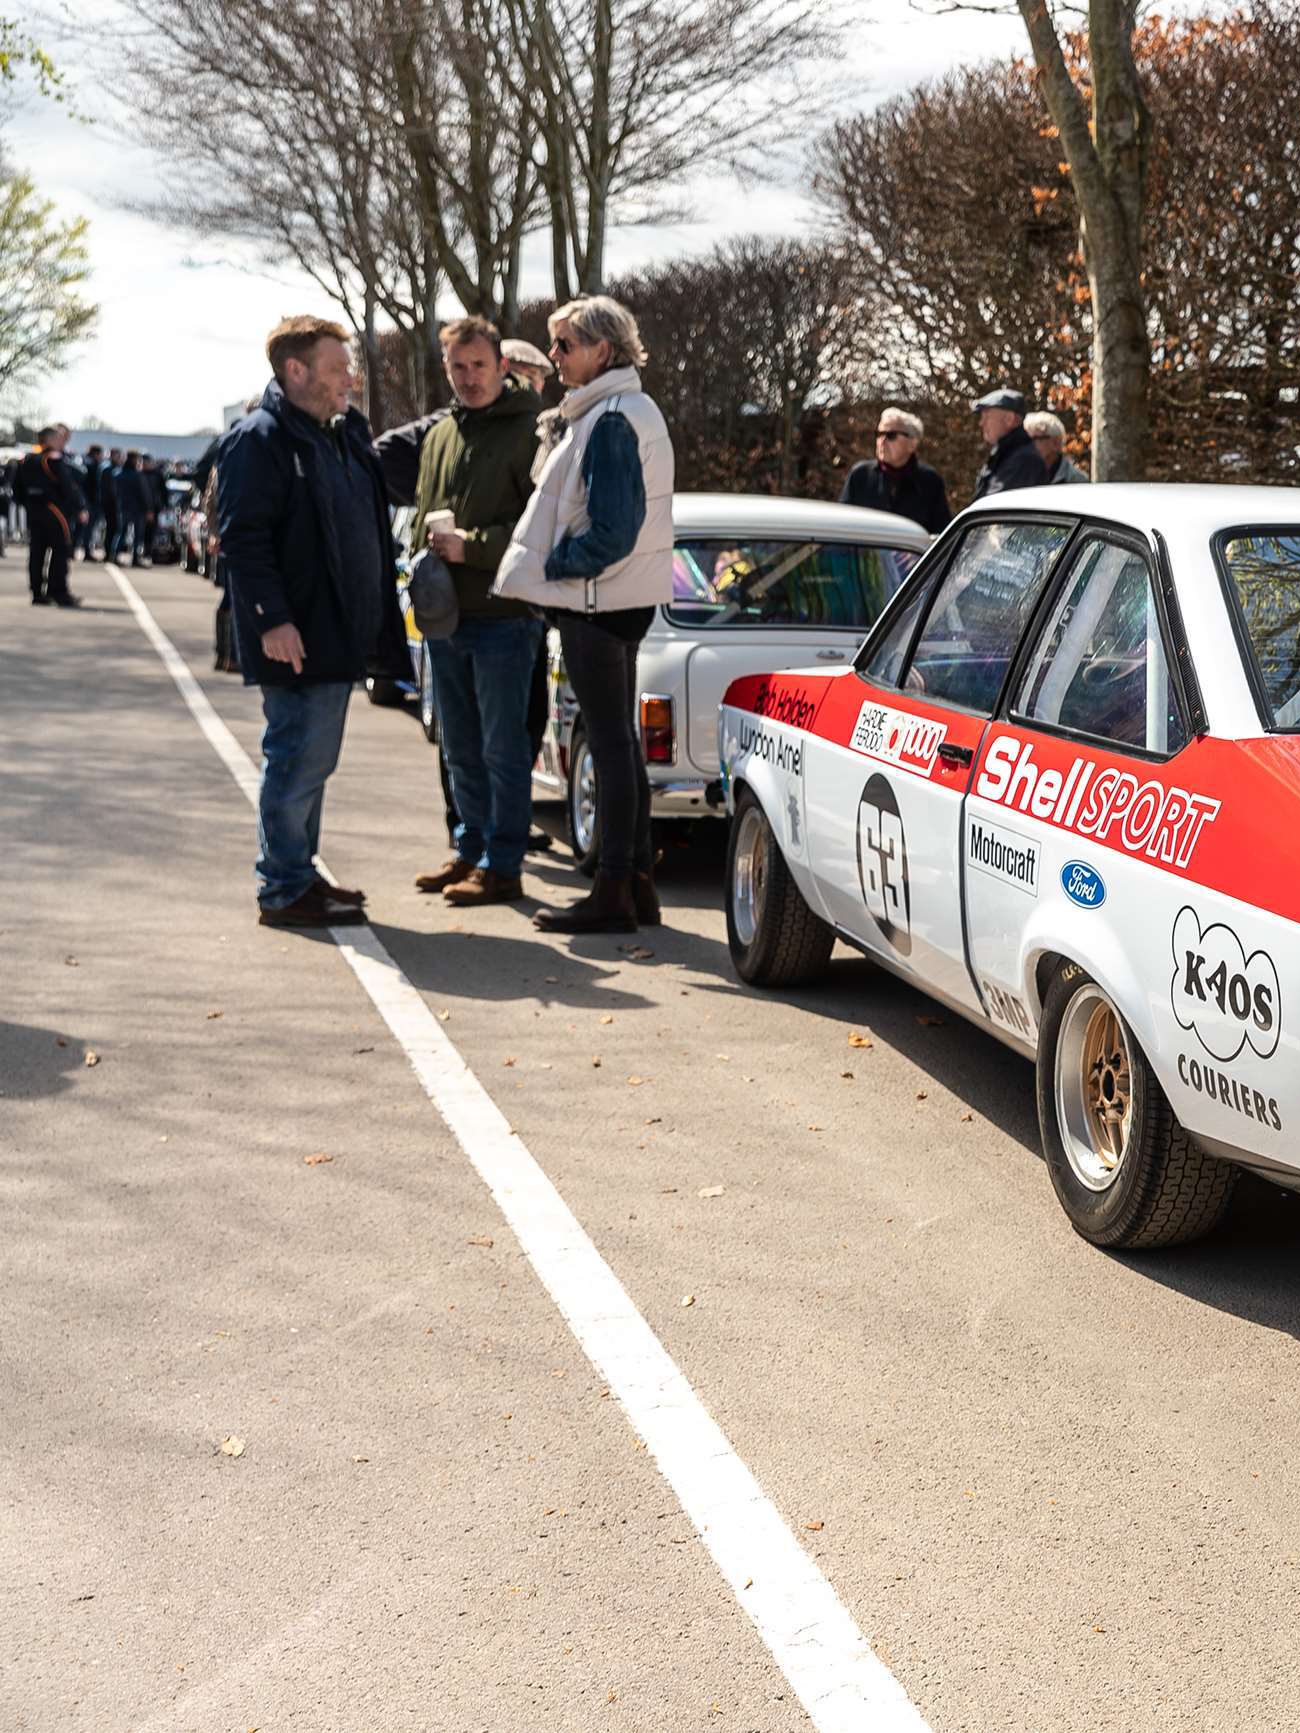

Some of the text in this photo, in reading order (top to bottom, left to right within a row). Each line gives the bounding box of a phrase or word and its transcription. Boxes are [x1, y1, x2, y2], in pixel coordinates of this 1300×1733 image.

[774, 688, 815, 733] Holden
[859, 799, 910, 933] 63
[970, 824, 1036, 886] Motorcraft
[1068, 865, 1097, 901] Ford
[983, 981, 1031, 1036] 3MP
[1185, 950, 1272, 1031] KAOS
[1177, 1053, 1282, 1131] COURIERS
